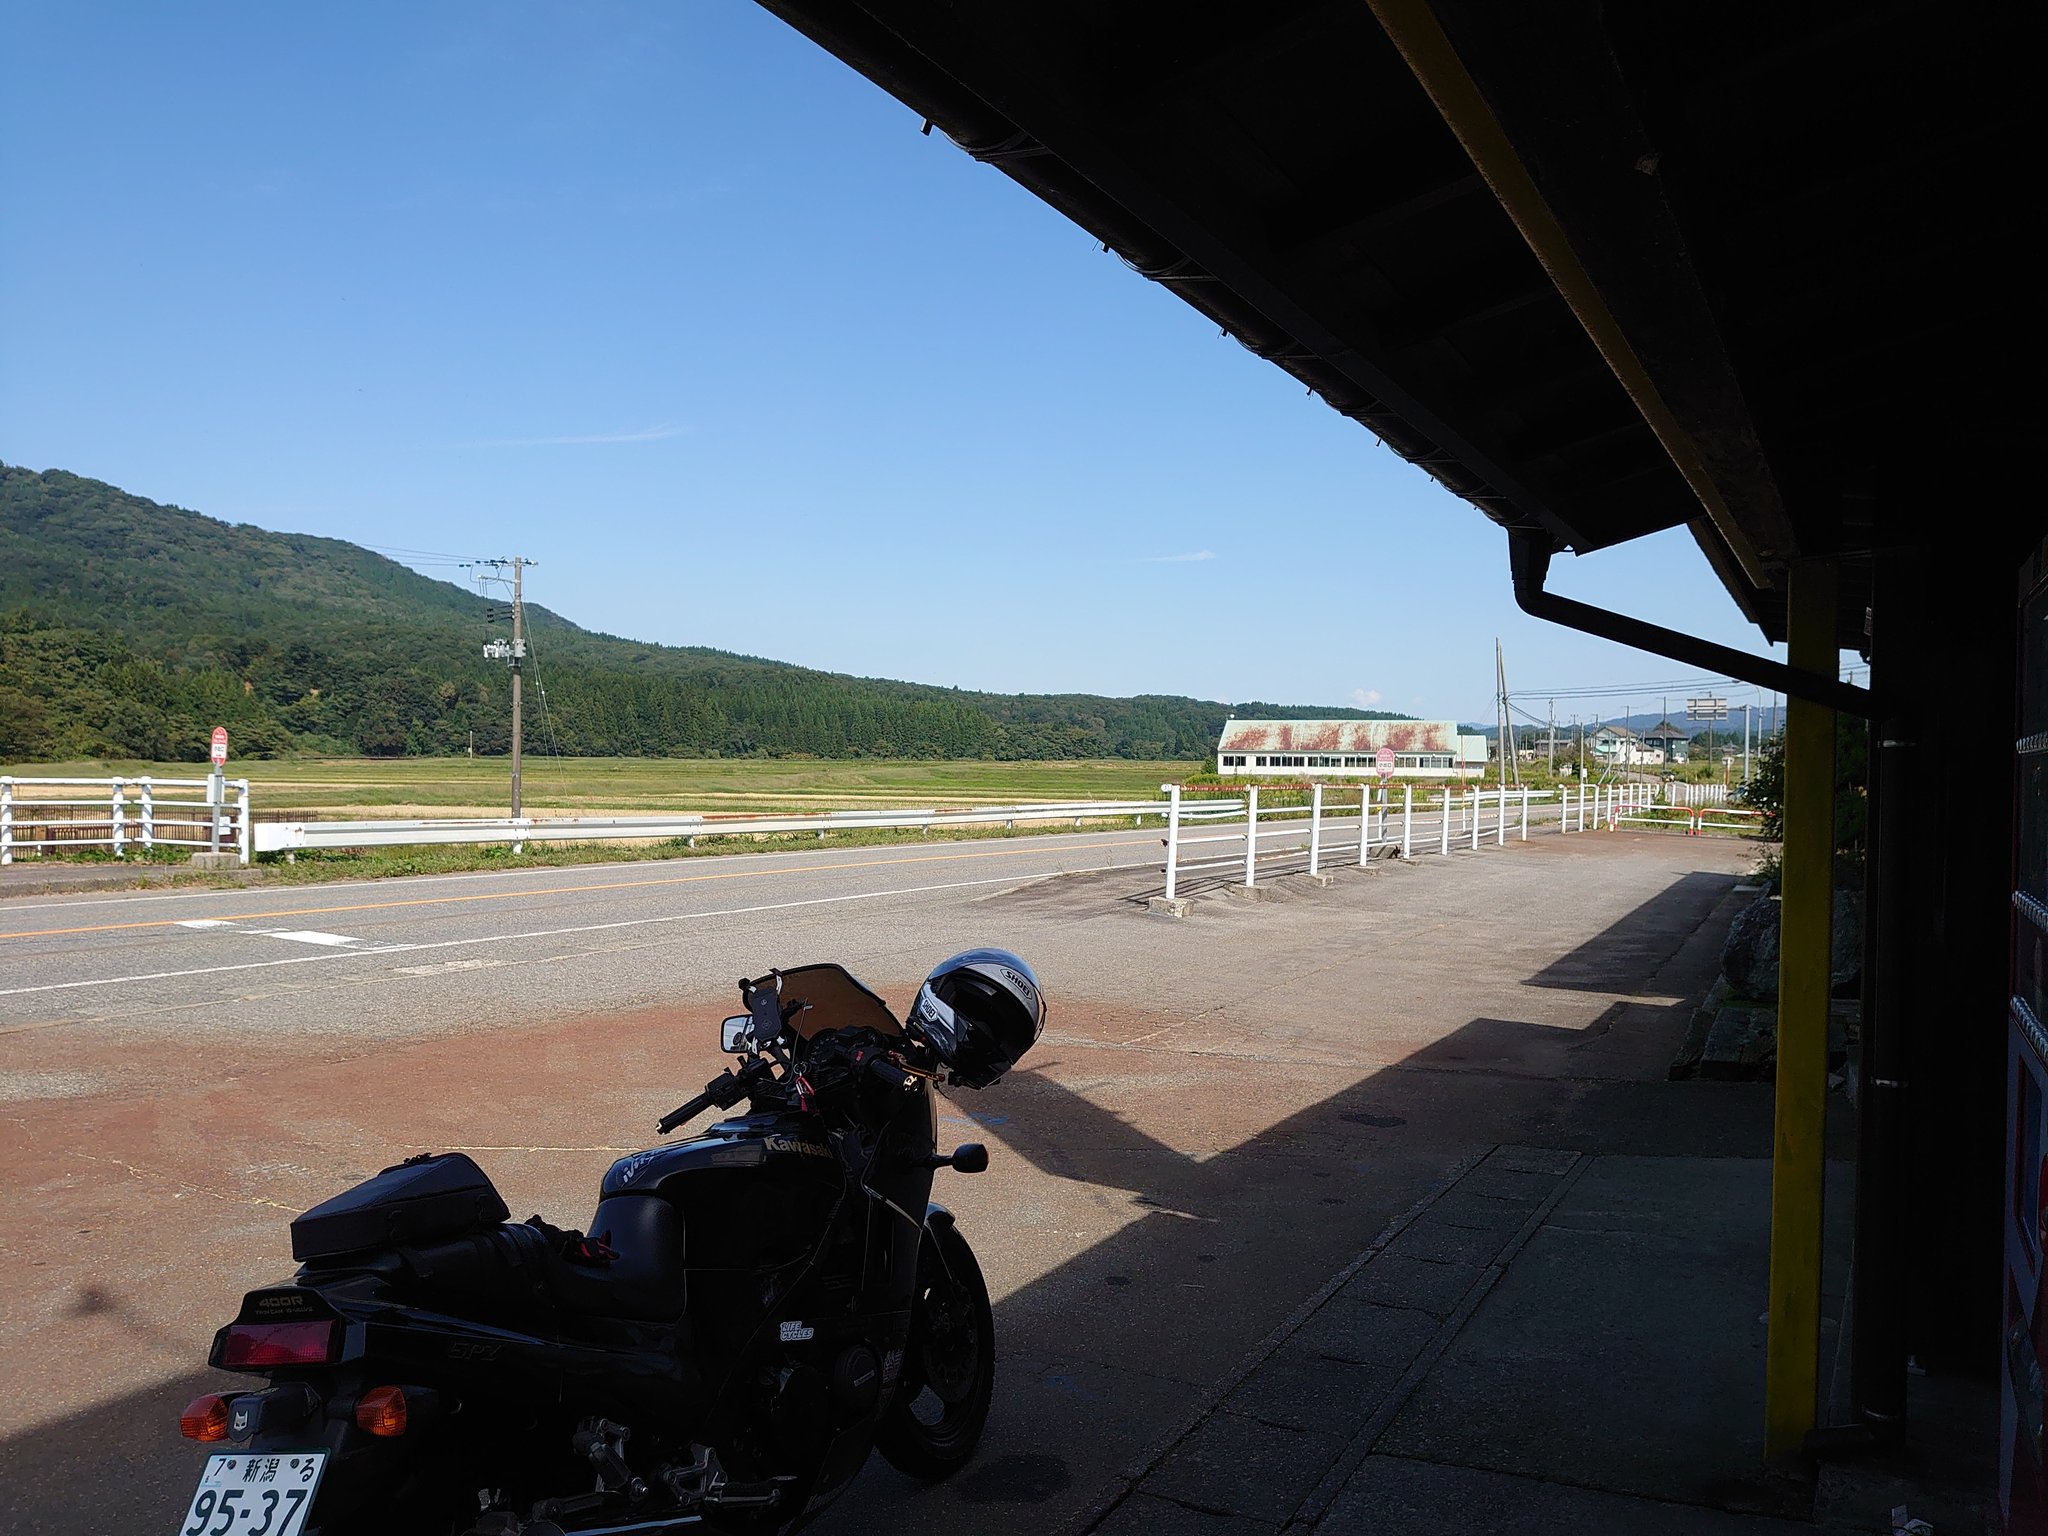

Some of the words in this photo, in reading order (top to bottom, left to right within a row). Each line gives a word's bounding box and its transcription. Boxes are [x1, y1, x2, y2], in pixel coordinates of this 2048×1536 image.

[1005, 970, 1031, 997] SHOEI
[922, 1000, 936, 1018] SHOEI
[763, 1136, 834, 1159] Kawasaki
[259, 1296, 303, 1307] 400R
[782, 1322, 801, 1331] LIFE
[782, 1329, 812, 1339] CYCLES
[213, 1458, 226, 1476] 7
[242, 1458, 281, 1483] 新潟
[299, 1457, 315, 1482] る
[185, 1489, 308, 1536] 95-37
